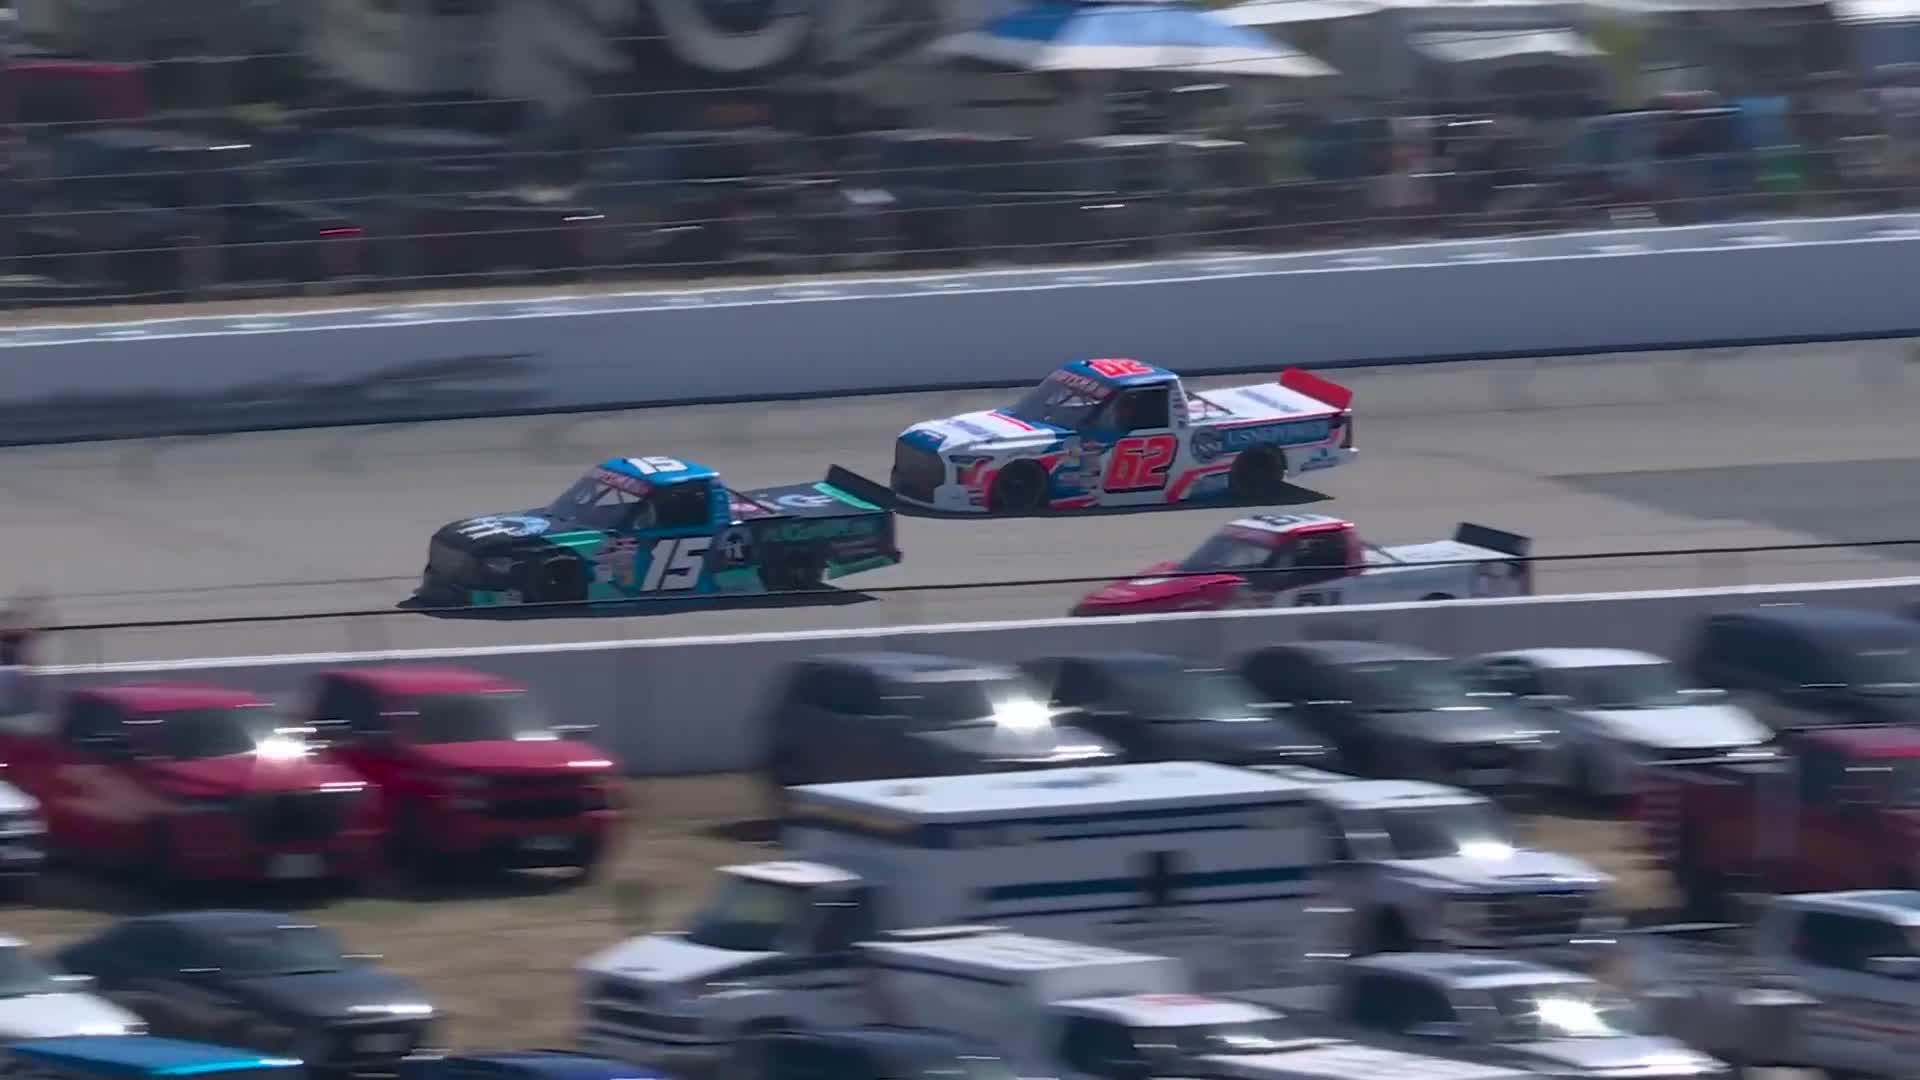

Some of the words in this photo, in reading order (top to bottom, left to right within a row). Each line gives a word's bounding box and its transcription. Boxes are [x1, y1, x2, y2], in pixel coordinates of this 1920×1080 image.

[1088, 358, 1153, 379] 62
[625, 455, 689, 475] 15
[1104, 433, 1178, 492] 62
[639, 536, 713, 592] 15
